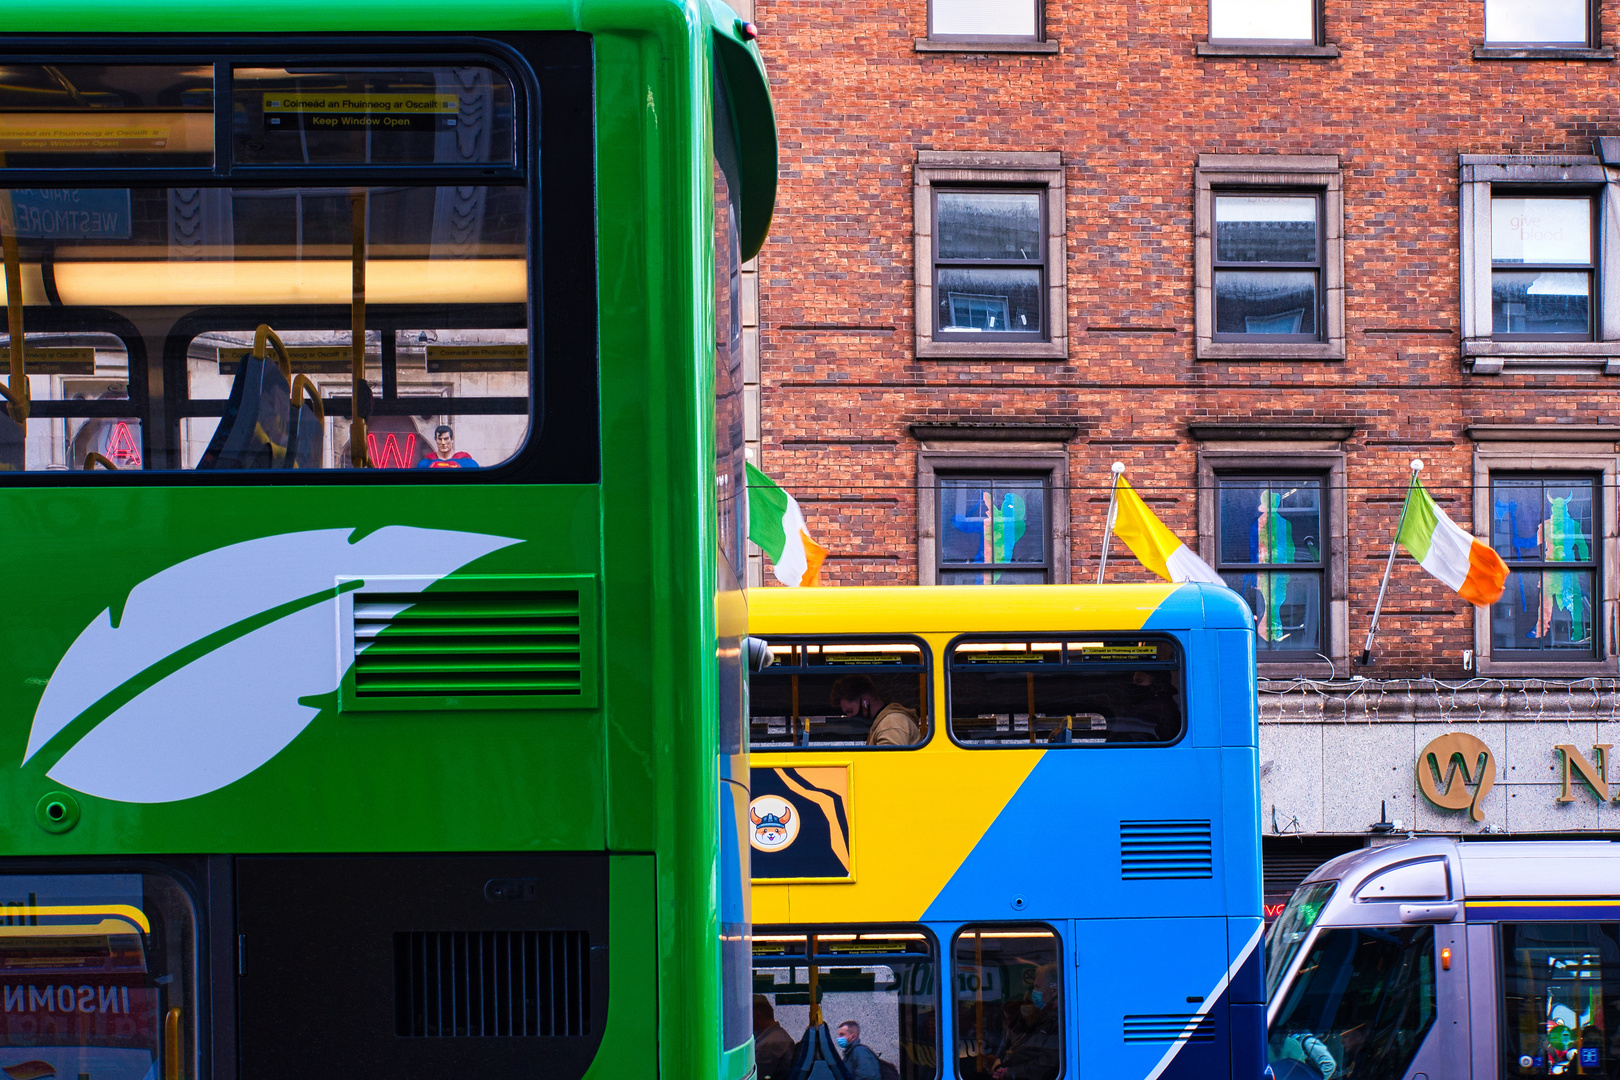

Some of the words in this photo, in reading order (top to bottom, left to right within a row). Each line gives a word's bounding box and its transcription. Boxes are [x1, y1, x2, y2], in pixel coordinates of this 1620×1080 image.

[342, 99, 391, 110] Fhuinneog
[405, 99, 437, 108] Oscailt
[312, 116, 338, 127] Keep
[341, 116, 381, 126] Window
[383, 116, 410, 127] Open
[21, 140, 47, 148] Keep
[92, 140, 119, 148] Open
[1510, 214, 1541, 231] give
[1520, 228, 1562, 241] blood
[105, 421, 141, 466] A
[367, 433, 416, 469] W
[1554, 743, 1620, 802] N
